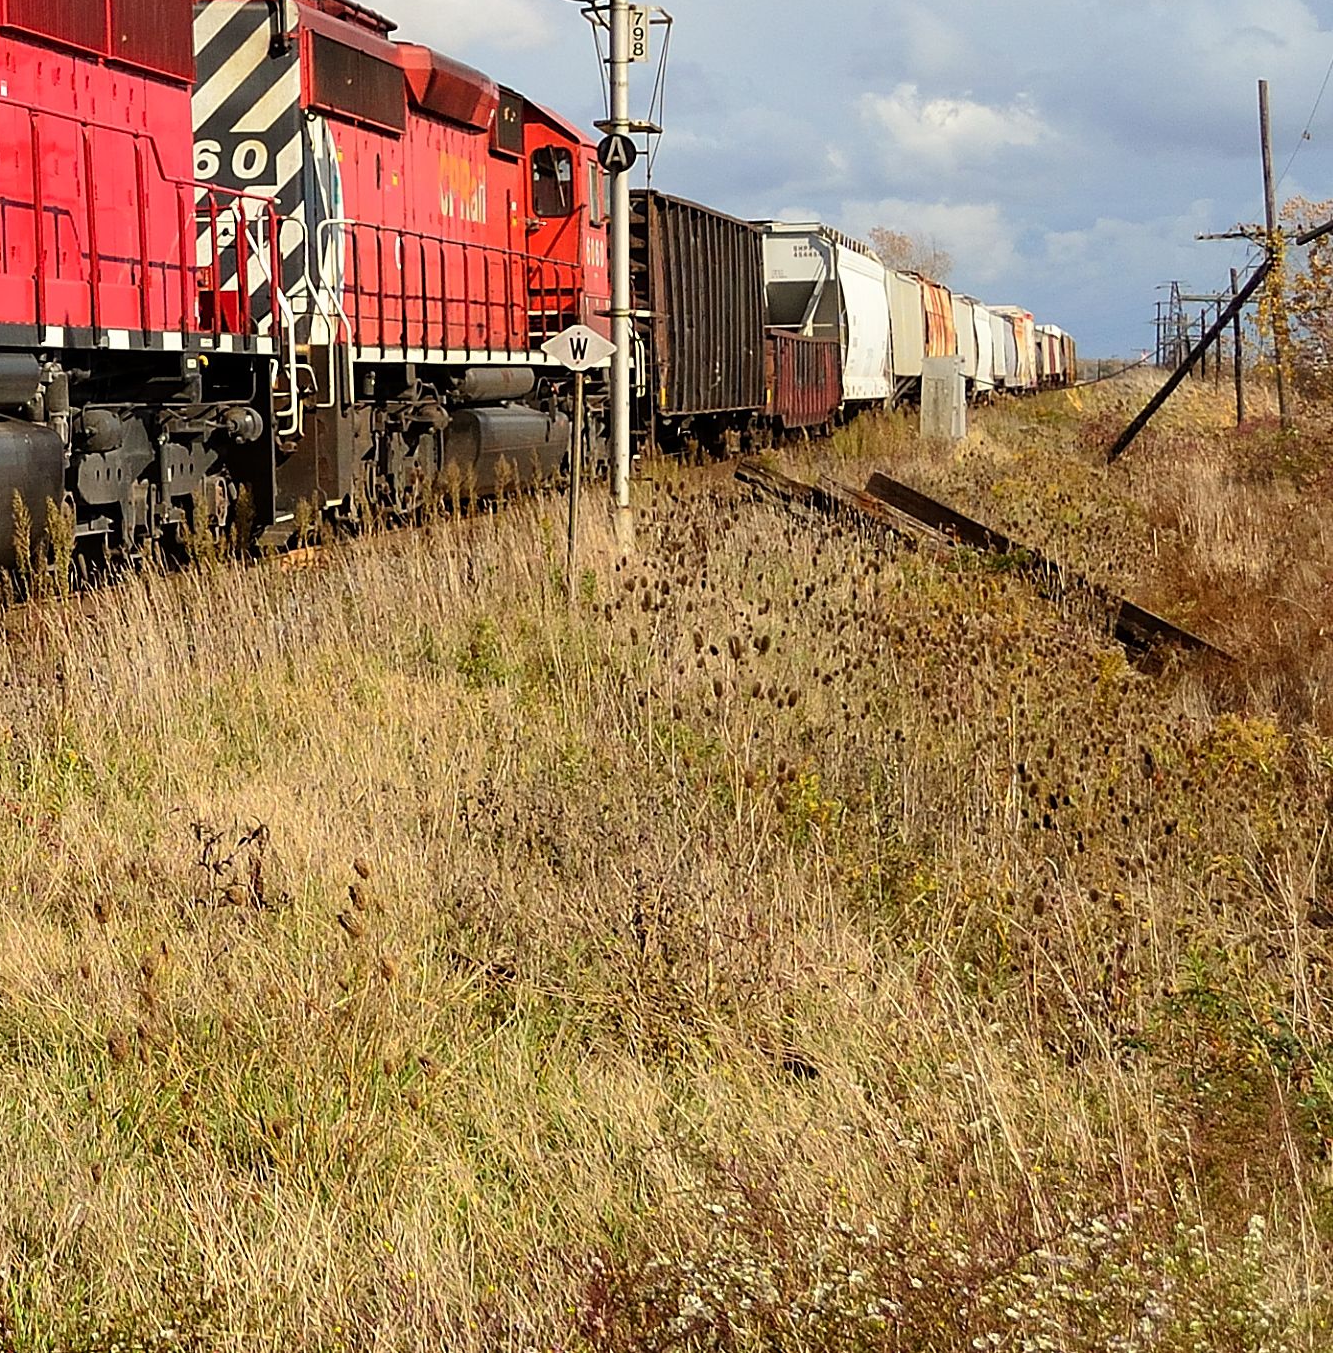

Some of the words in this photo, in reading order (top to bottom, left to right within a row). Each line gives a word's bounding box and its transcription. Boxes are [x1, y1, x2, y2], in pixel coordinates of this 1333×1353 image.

[633, 12, 644, 56] 798
[192, 139, 268, 180] 60
[605, 136, 628, 167] A
[569, 337, 588, 360] W
